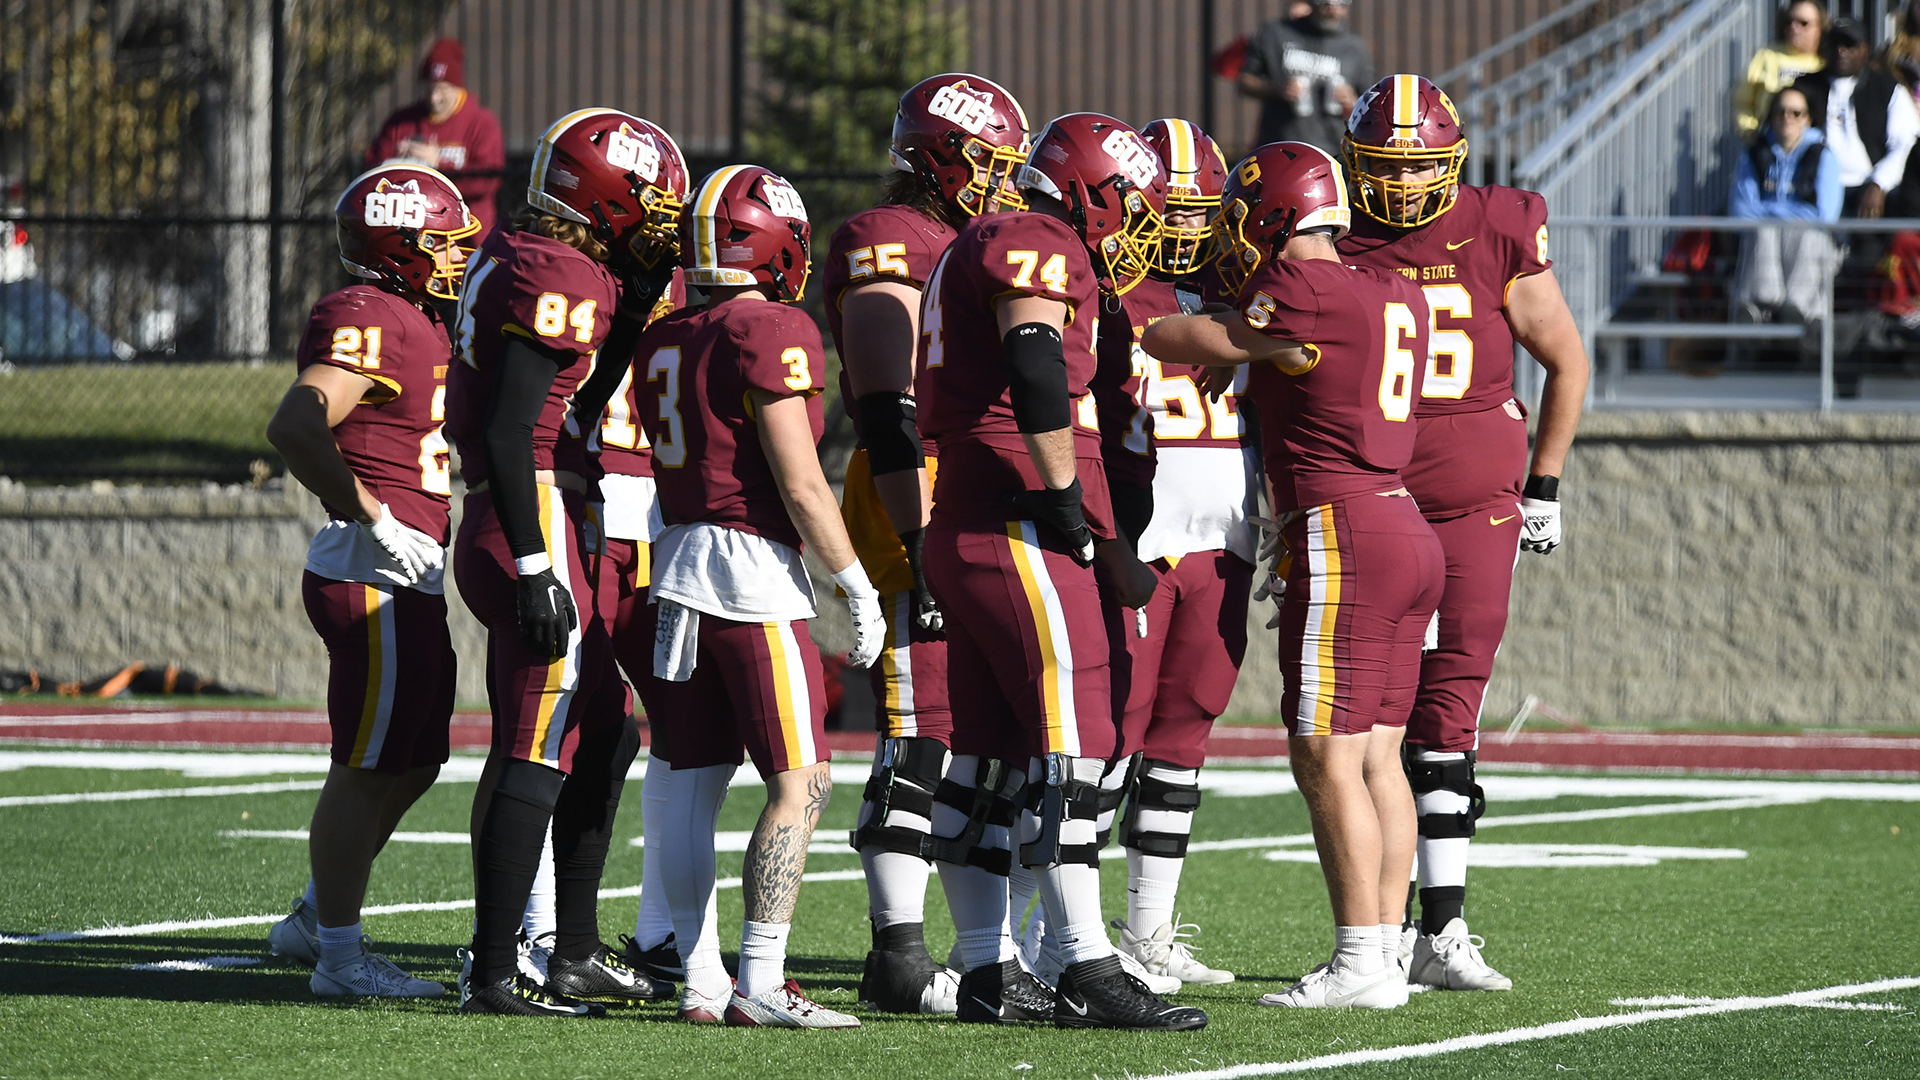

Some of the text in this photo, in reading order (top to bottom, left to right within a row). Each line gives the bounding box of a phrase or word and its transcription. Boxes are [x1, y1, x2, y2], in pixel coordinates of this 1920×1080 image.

[928, 86, 995, 135] 605
[606, 131, 661, 183] 605
[1102, 129, 1158, 189] 605
[1395, 139, 1415, 148] 605
[1171, 186, 1192, 196] 605
[1237, 155, 1262, 187] 6
[365, 192, 427, 228] 605
[1322, 209, 1338, 222] WIN
[724, 271, 748, 284] GAP
[845, 243, 909, 280] 55
[1007, 250, 1069, 294] 74
[1422, 264, 1456, 280] STATE
[533, 292, 597, 344] 84
[918, 247, 954, 371] 4
[1245, 290, 1277, 329] 6
[331, 326, 382, 369] 21
[1378, 302, 1417, 422] 6
[1421, 283, 1474, 399] 6
[781, 347, 813, 390] 3
[647, 345, 687, 468] 3
